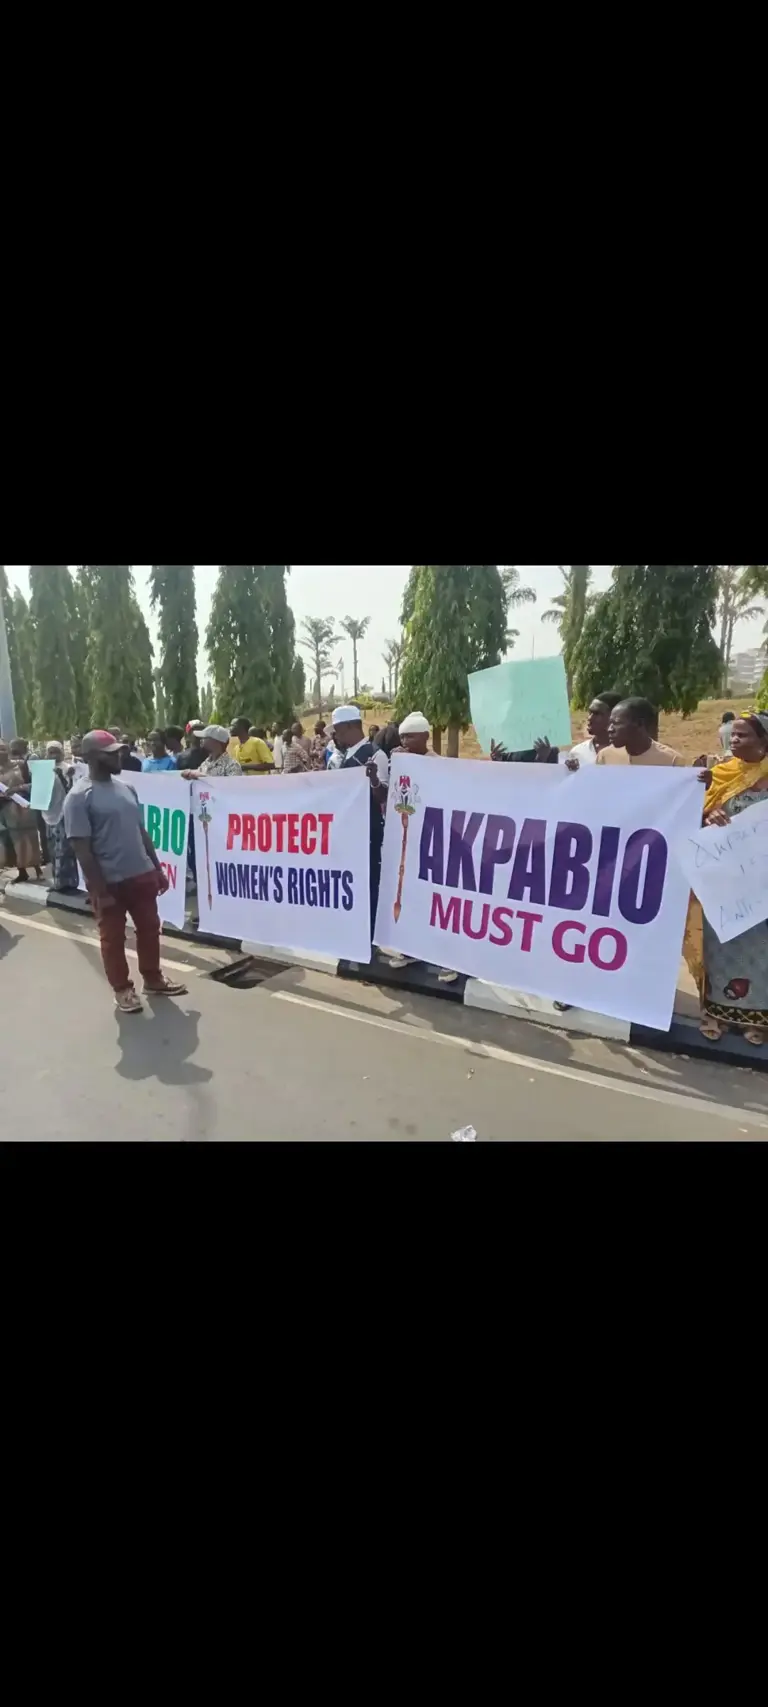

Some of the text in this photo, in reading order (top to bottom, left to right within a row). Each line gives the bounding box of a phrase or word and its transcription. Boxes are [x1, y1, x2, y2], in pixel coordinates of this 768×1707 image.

[226, 813, 334, 856] PROTECT
[418, 806, 668, 925] AKPABIO
[215, 861, 354, 912] WOMEN'S RIGHTS
[429, 892, 628, 971] MUST GO
